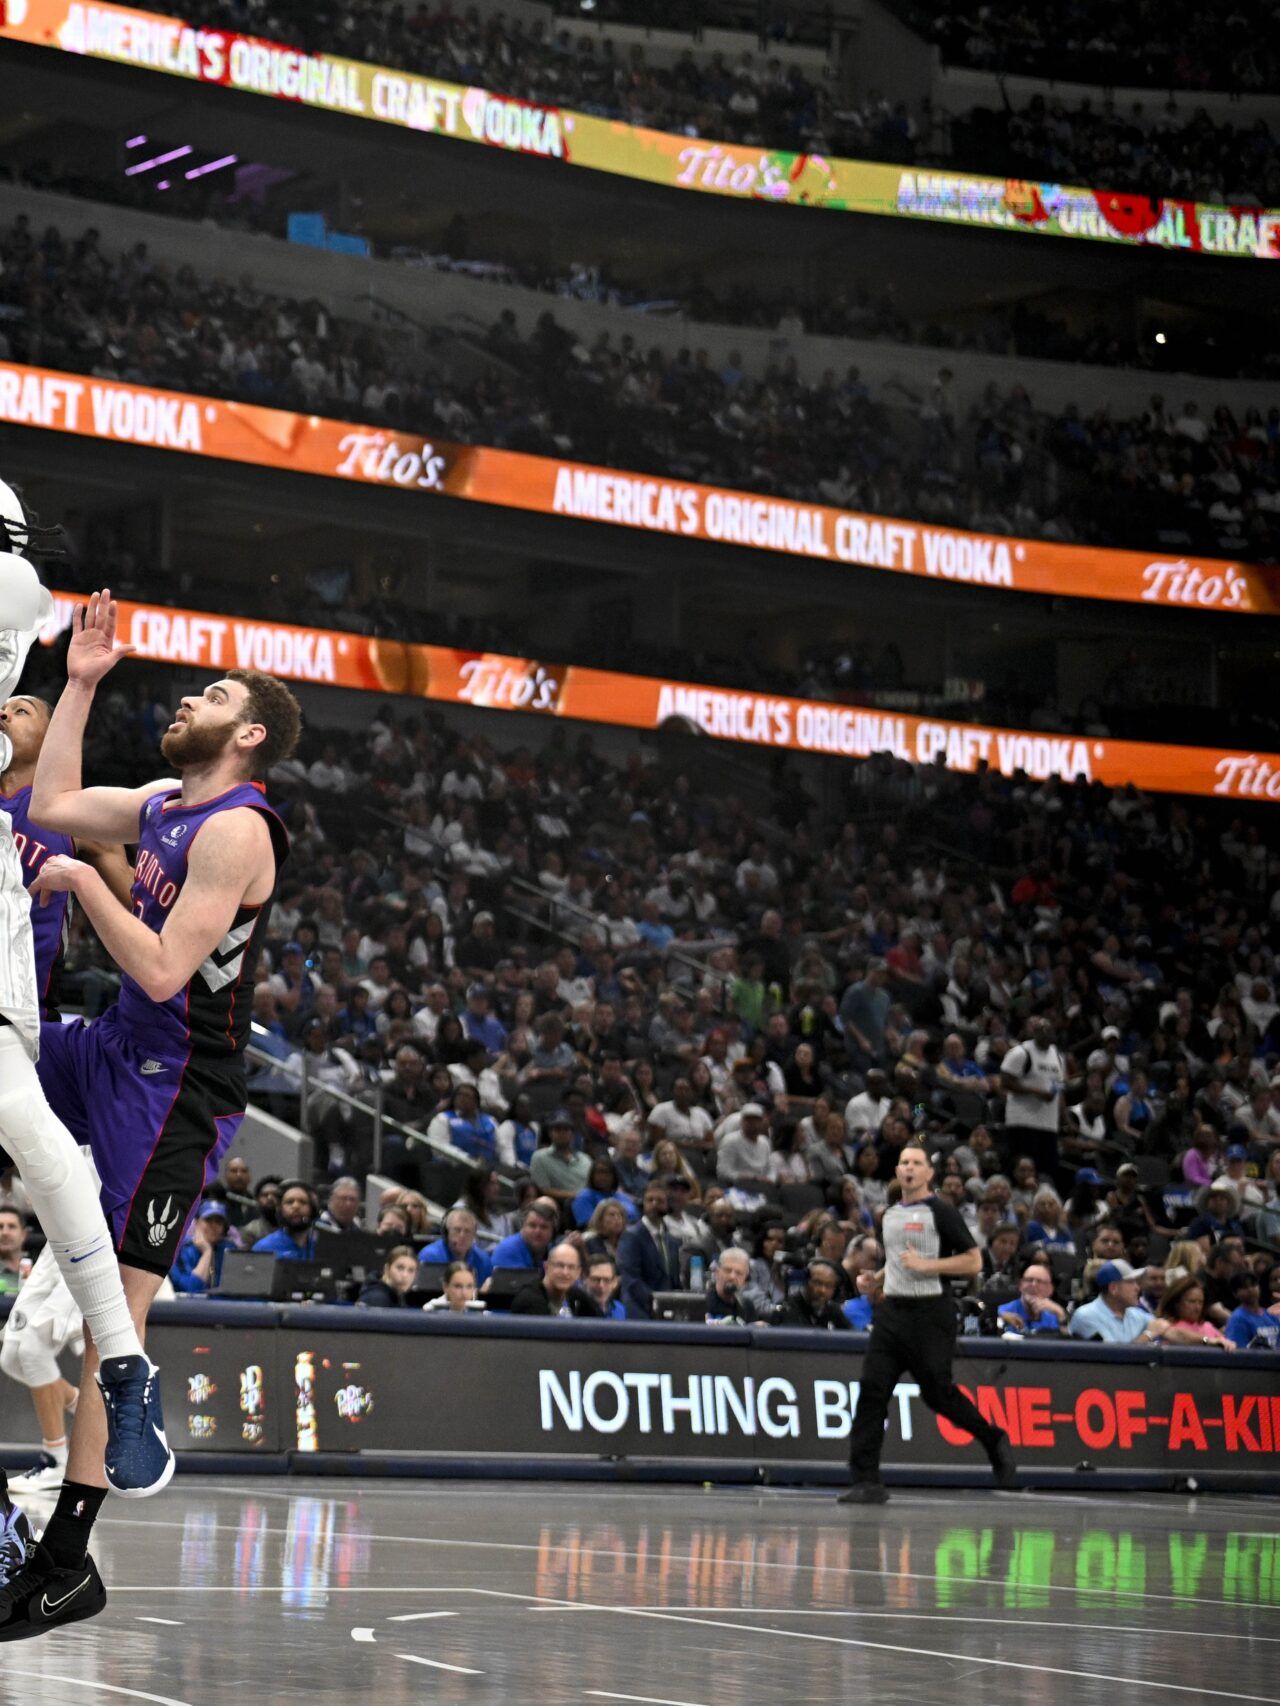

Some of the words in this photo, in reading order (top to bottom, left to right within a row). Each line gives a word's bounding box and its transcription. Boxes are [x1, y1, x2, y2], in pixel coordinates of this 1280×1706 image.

[67, 5, 225, 80] AMERICA'S
[230, 41, 365, 112] ORIGINAL
[371, 72, 460, 131] CRAFT
[468, 92, 564, 158] VODKA
[90, 387, 203, 452] VODKA
[337, 433, 445, 490] Tito's
[552, 467, 699, 535] AMERICA'S
[704, 494, 828, 557] ORIGINAL
[835, 515, 917, 570] CRAFT
[923, 531, 1014, 586] VODKA
[1142, 559, 1250, 608] Tito's
[130, 608, 227, 667] CRAFT
[233, 623, 337, 681] VODKA
[459, 659, 559, 710] Tito's
[657, 685, 792, 745] AMERICA'S
[796, 704, 912, 762] ORIGINAL
[997, 734, 1093, 783] VODKA
[538, 1369, 800, 1439] NOTHING
[814, 1379, 921, 1441] BT
